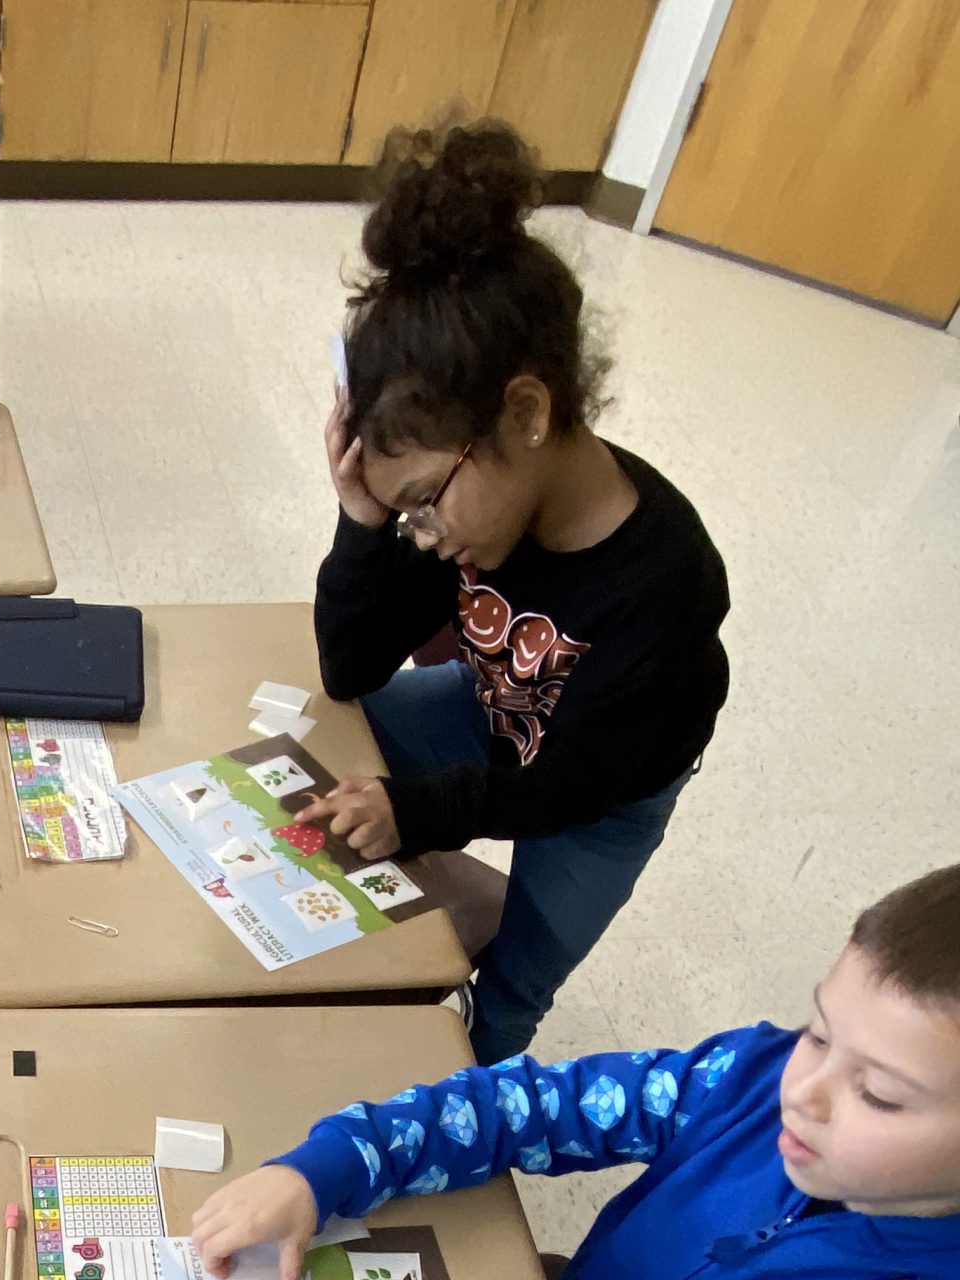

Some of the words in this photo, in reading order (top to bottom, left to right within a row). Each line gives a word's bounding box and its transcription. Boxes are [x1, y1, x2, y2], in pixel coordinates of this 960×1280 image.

[237, 902, 261, 926] WEEK
[230, 907, 285, 963] AGRICULTURAL
[258, 924, 295, 962] LITERACY
